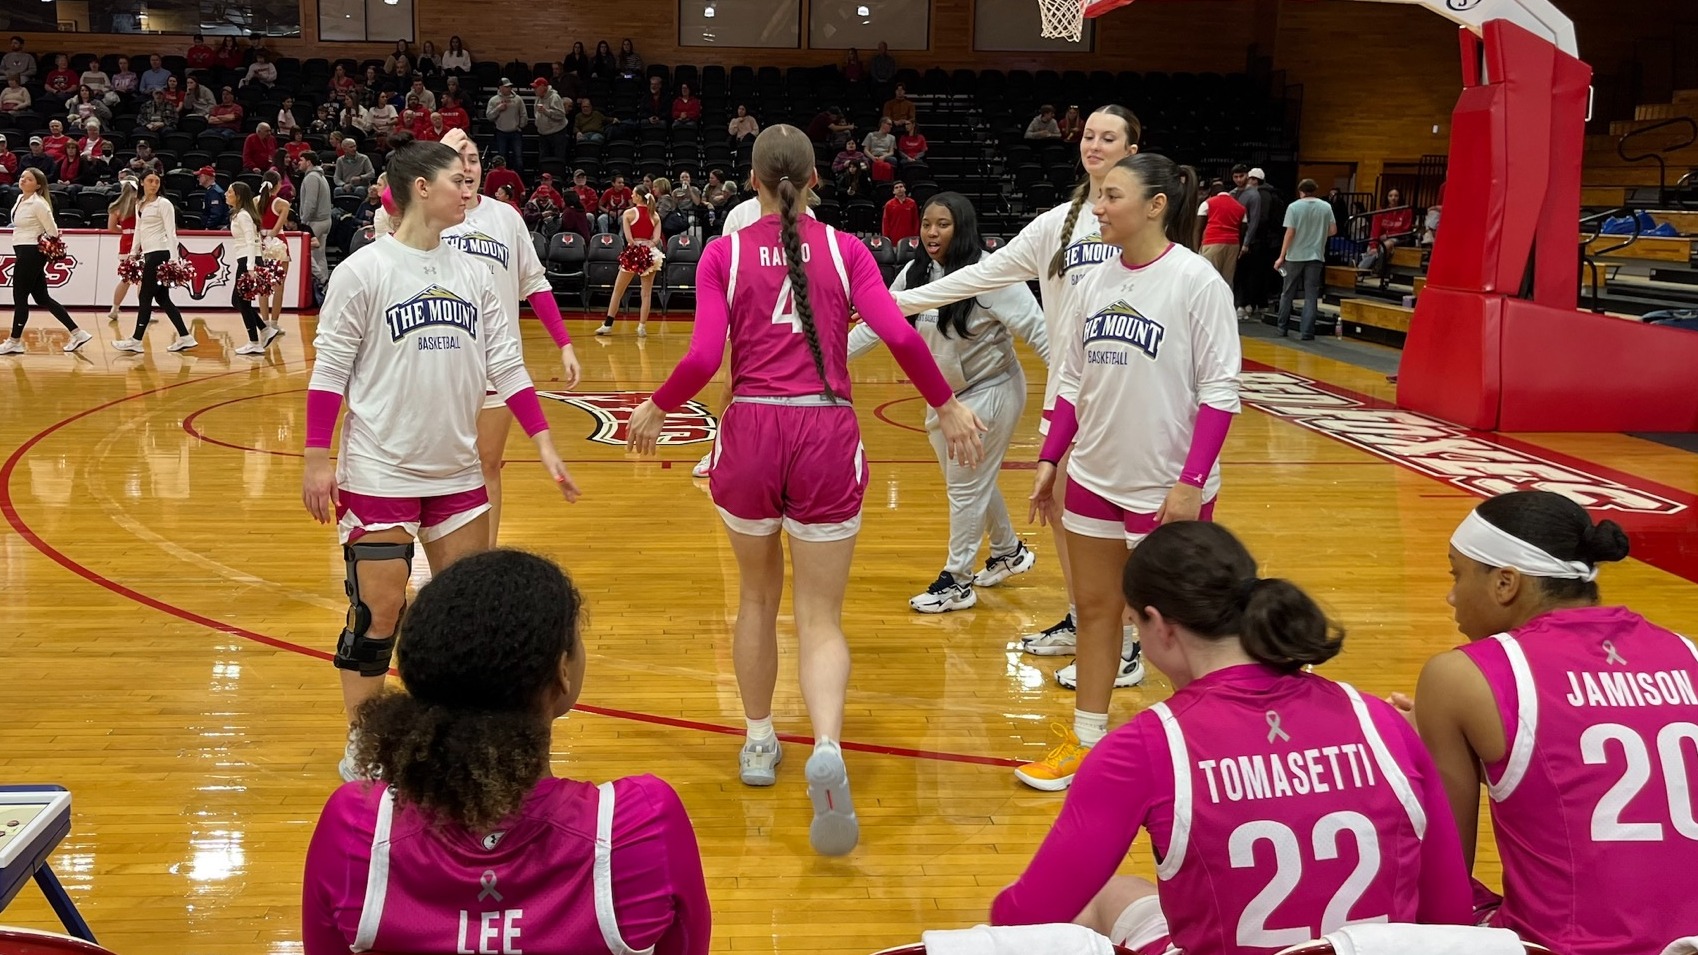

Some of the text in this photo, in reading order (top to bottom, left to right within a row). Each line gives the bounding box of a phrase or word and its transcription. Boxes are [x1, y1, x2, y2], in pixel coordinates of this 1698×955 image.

[469, 238, 509, 267] MOUNT
[1063, 244, 1123, 267] HE MOU
[388, 300, 477, 337] THE MOUNT
[772, 274, 803, 333] 4
[418, 336, 461, 350] BASKETBALL
[1084, 315, 1161, 353] HE MOUNT
[1088, 350, 1128, 366] BASKETBALL
[1566, 669, 1698, 707] JAMISON
[1198, 743, 1376, 804] TOMASETTI
[1579, 721, 1698, 842] 20
[1228, 810, 1389, 948] 22
[457, 908, 523, 955] LEE
